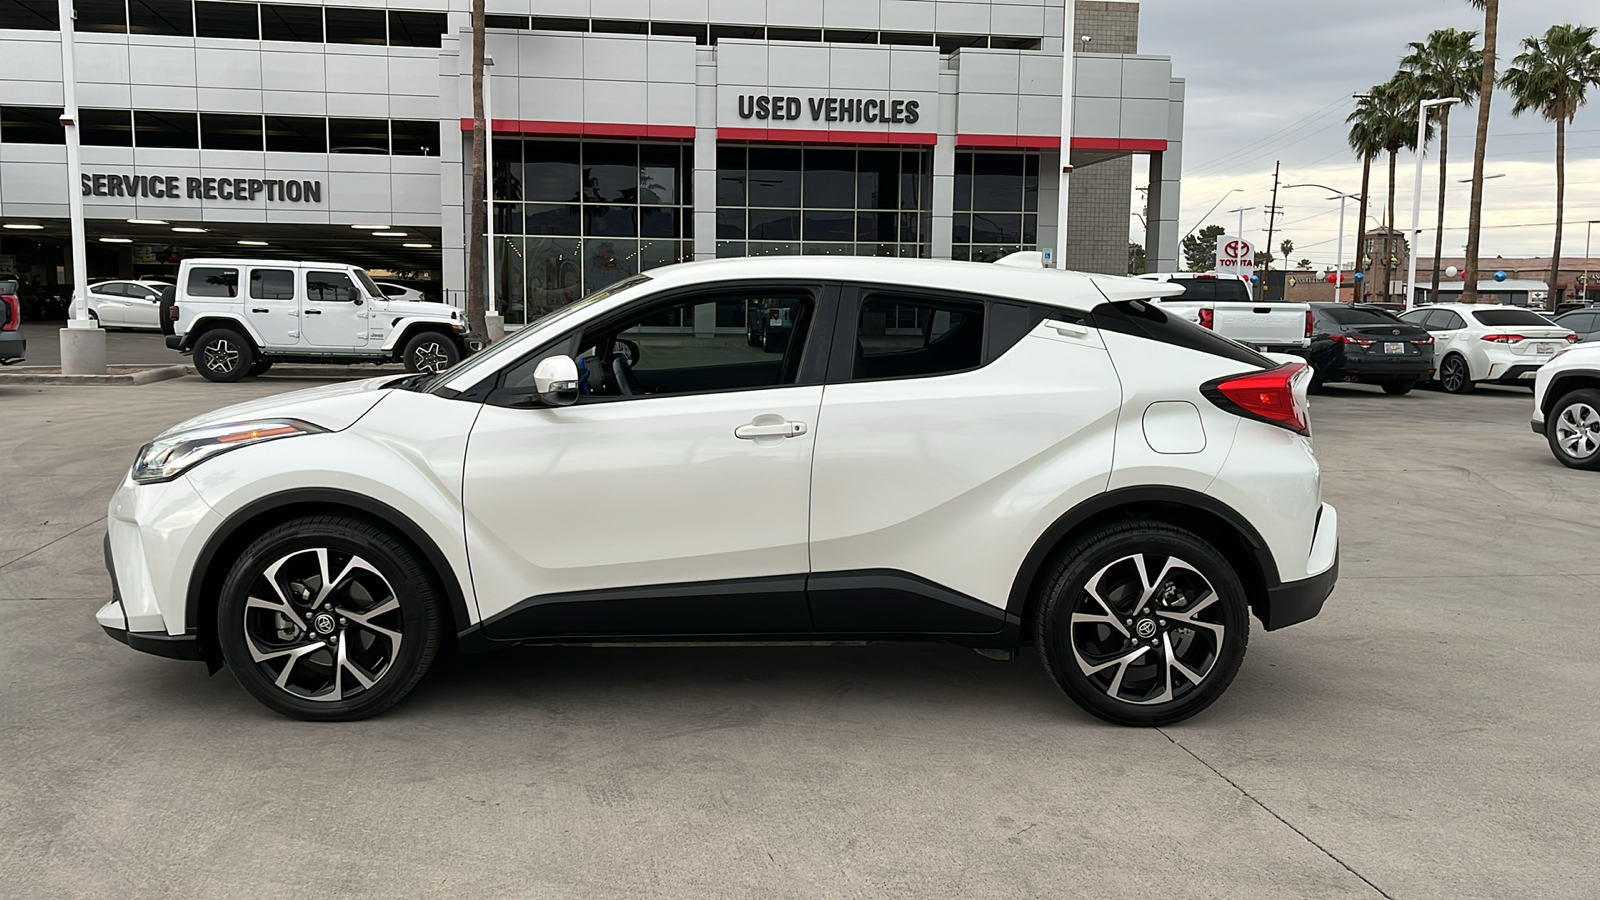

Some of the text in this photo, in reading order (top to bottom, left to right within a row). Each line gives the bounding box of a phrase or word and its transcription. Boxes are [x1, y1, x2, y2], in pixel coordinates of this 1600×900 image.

[738, 95, 920, 124] USED VEHICLES
[81, 173, 321, 203] SERVICE RECEPTION
